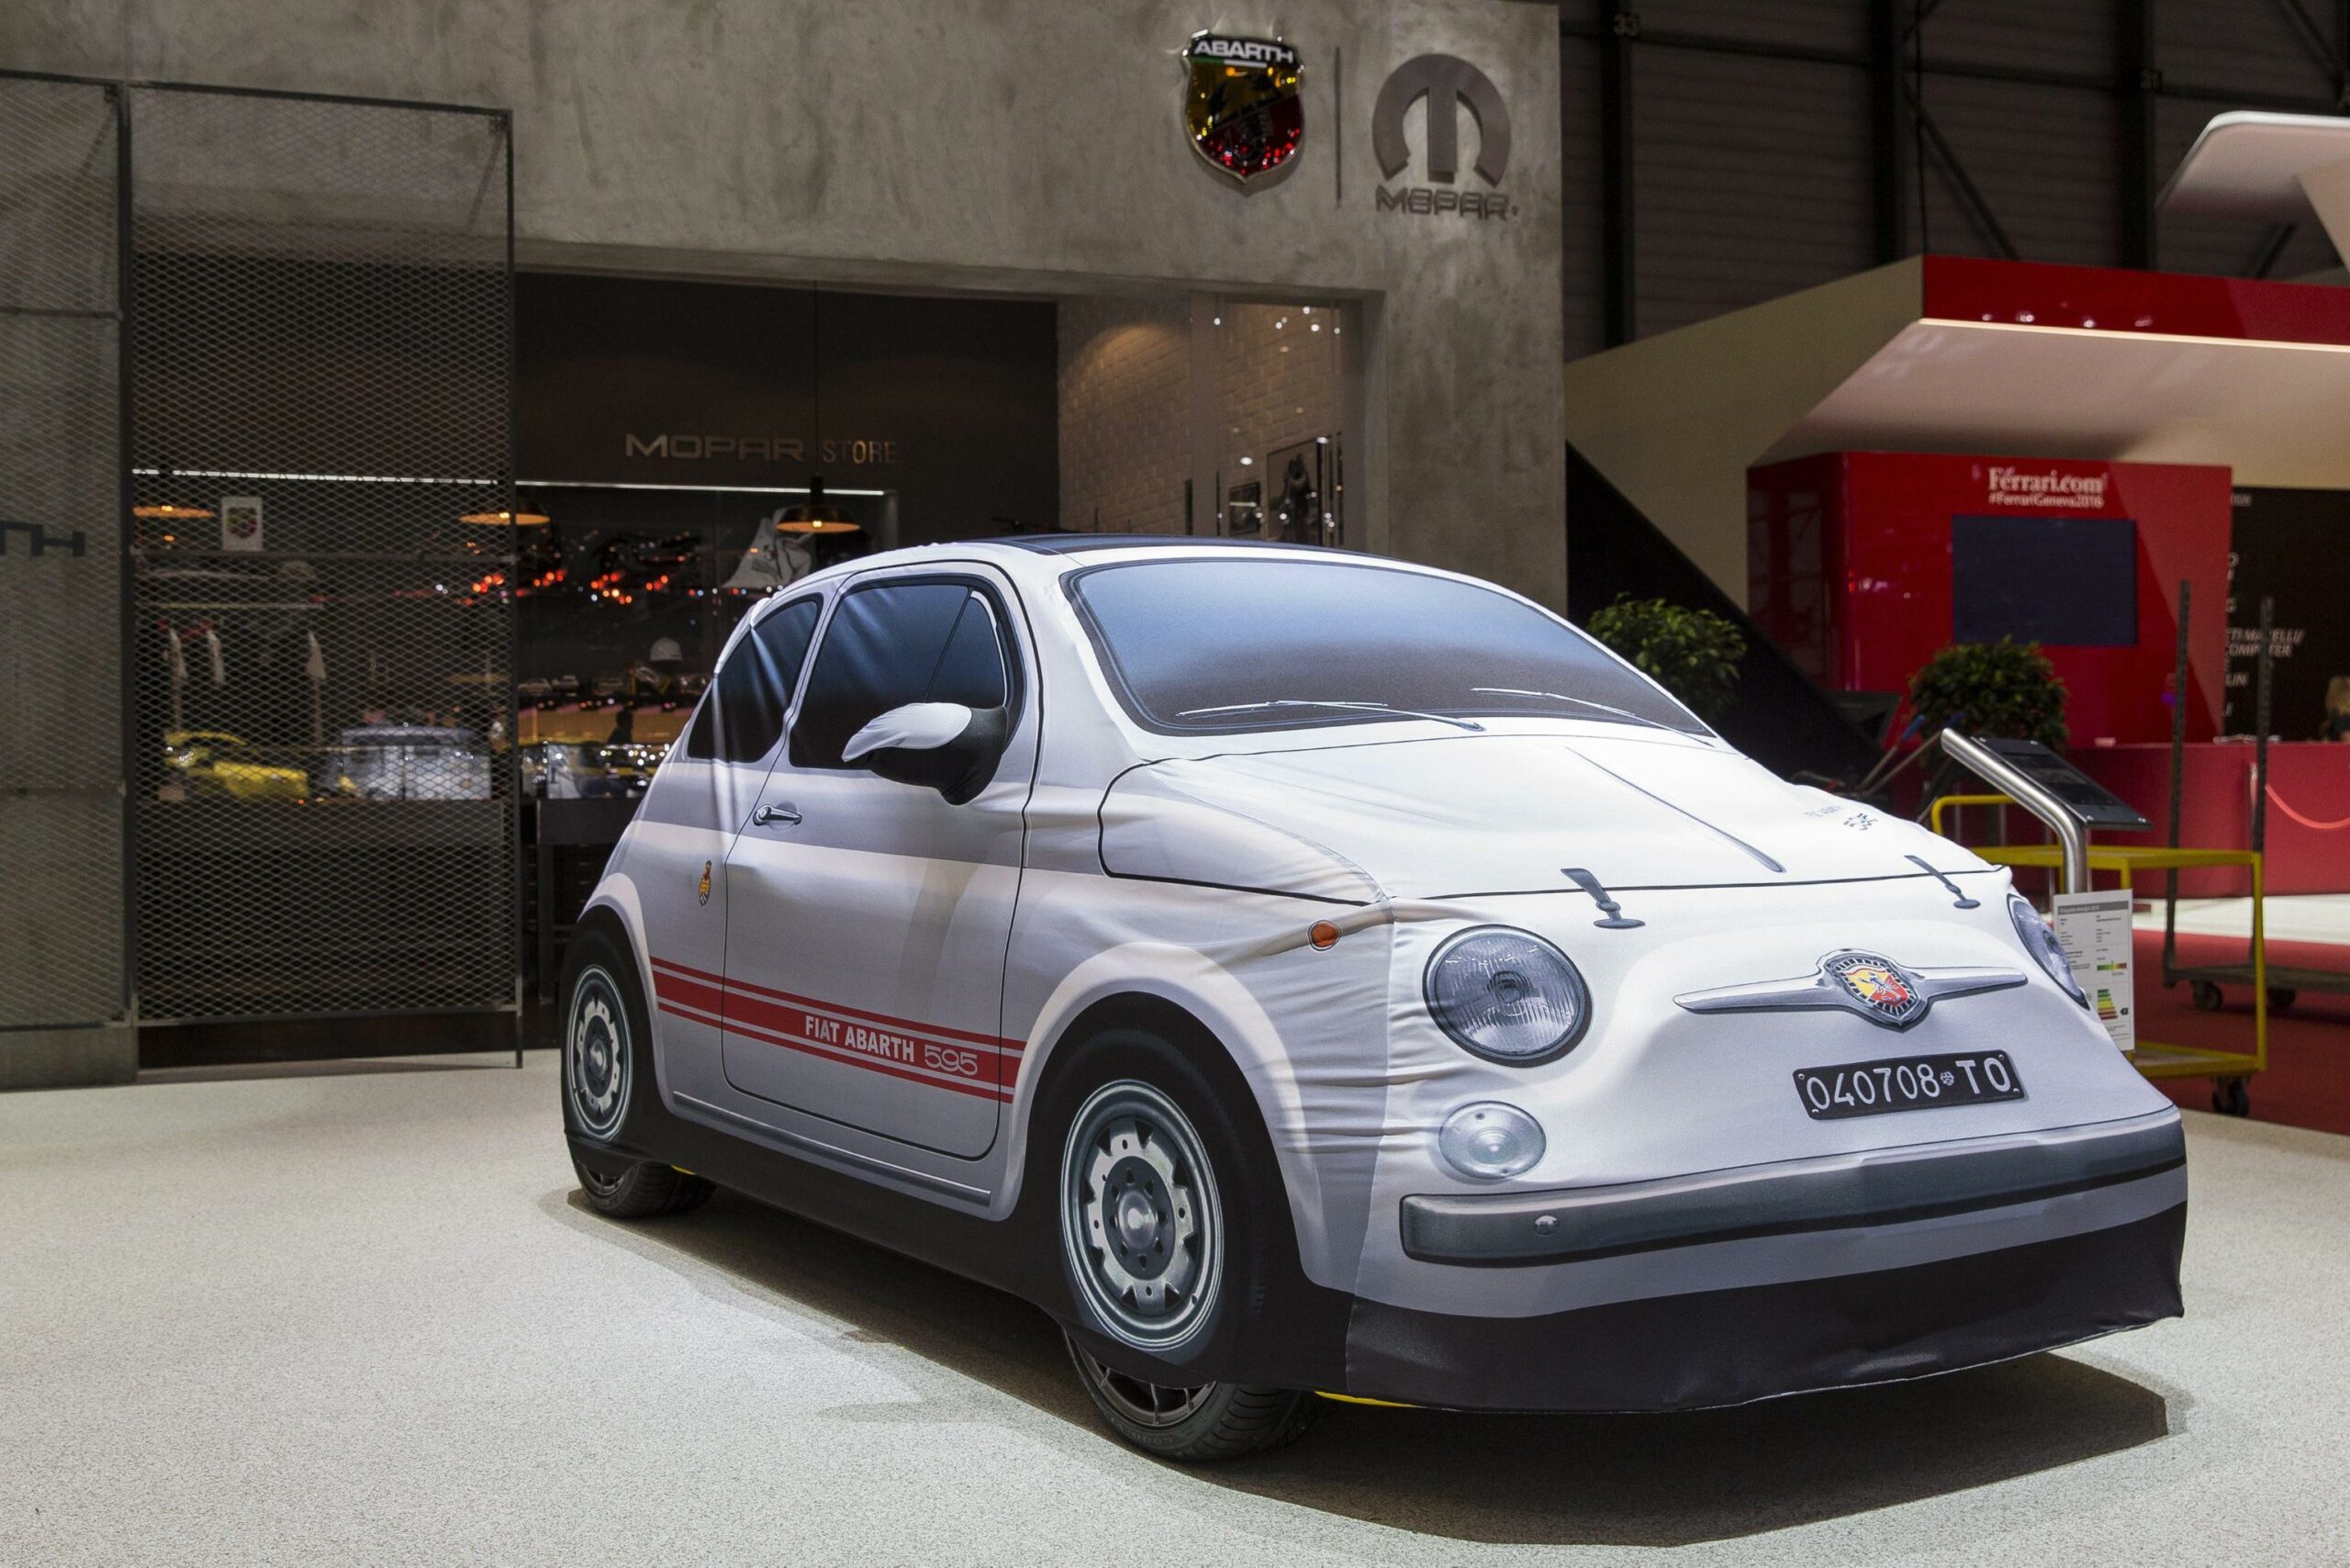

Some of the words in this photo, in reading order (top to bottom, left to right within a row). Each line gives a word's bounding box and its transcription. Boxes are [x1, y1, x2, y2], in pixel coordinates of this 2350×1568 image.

[1193, 39, 1294, 64] ABARTH
[626, 433, 804, 462] MOPAR
[822, 440, 897, 464] STORE
[1988, 466, 2104, 494] Ferrari.com
[805, 1015, 840, 1043] FIAT
[845, 1026, 914, 1063] ABARTH
[924, 1044, 978, 1076] 595
[1807, 1064, 1941, 1110] 040708
